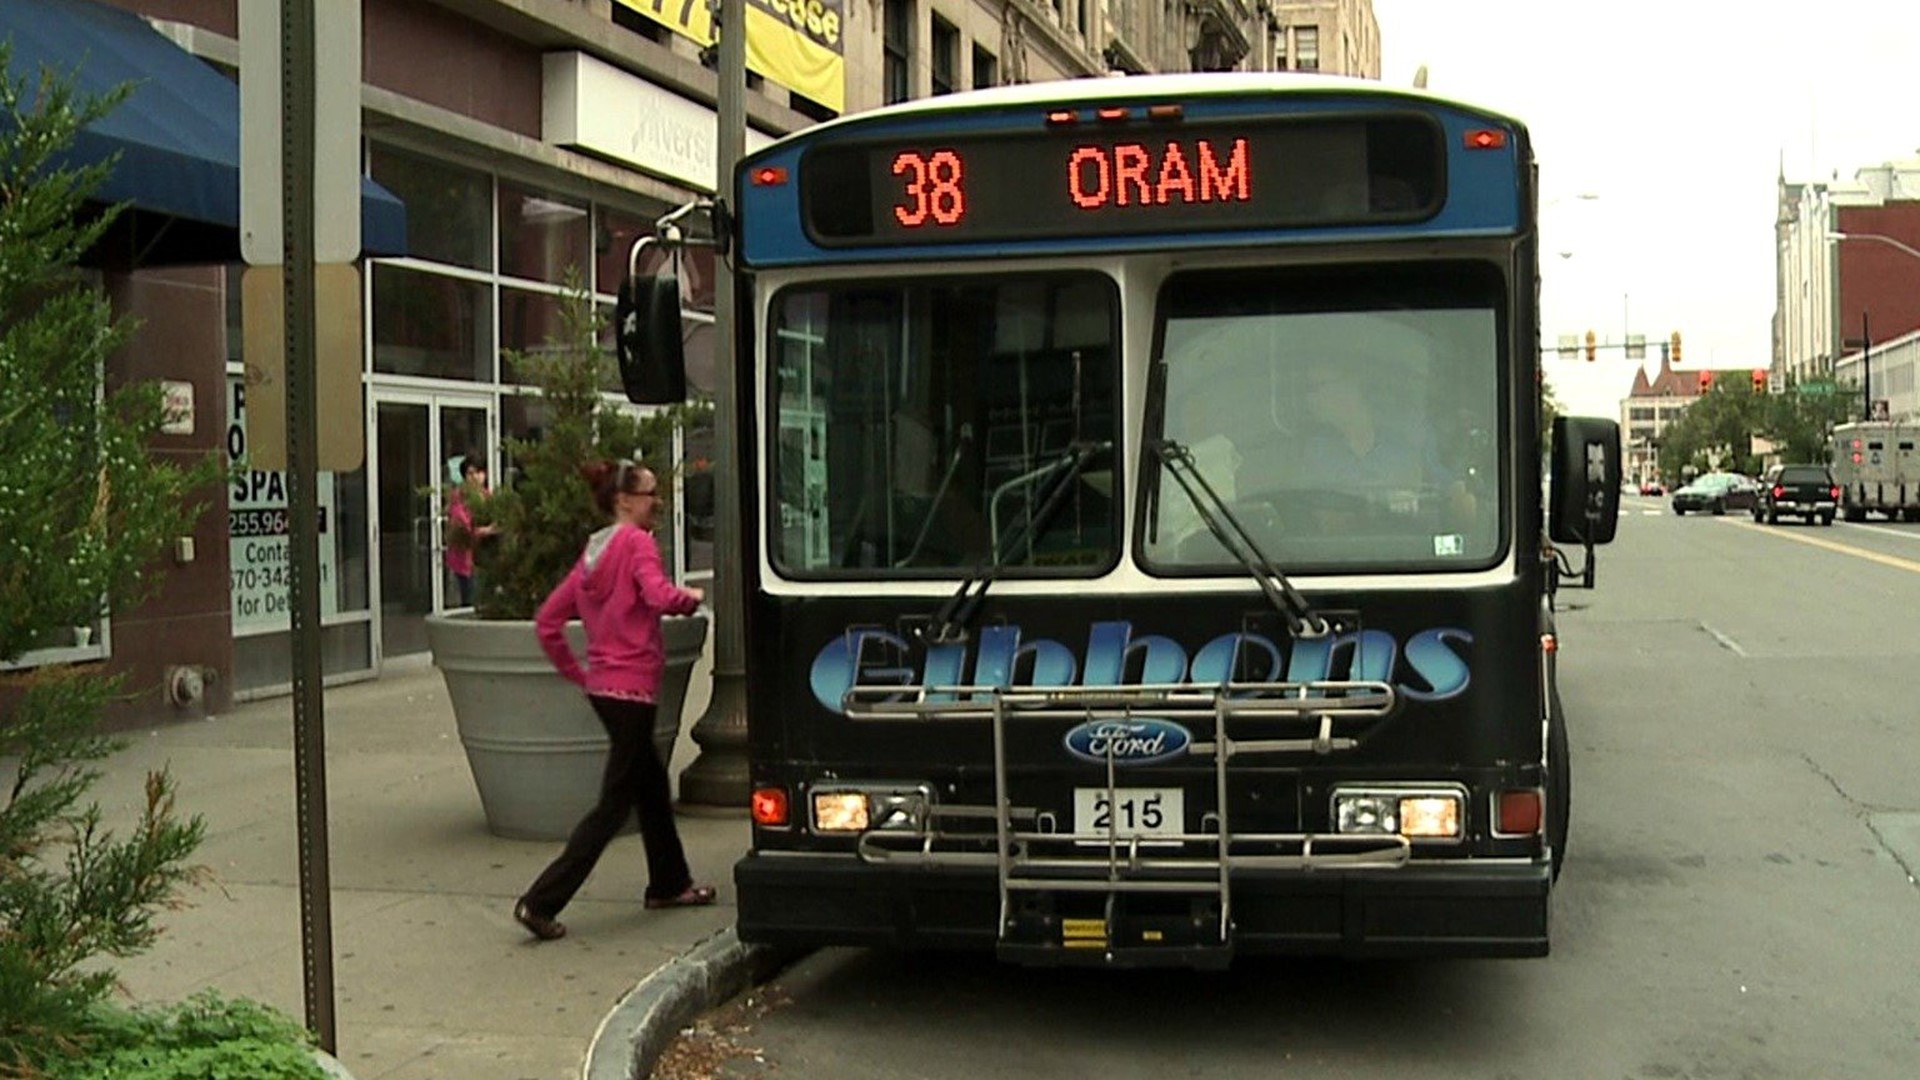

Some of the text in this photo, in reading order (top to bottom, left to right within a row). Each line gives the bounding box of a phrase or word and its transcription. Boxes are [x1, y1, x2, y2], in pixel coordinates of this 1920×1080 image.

[761, 0, 839, 44] ase
[893, 137, 1252, 226] 38 ORAM
[233, 470, 284, 501] SPA
[810, 621, 1475, 713] Gibbons
[1089, 724, 1165, 756] Ford
[1093, 799, 1163, 829] 215
